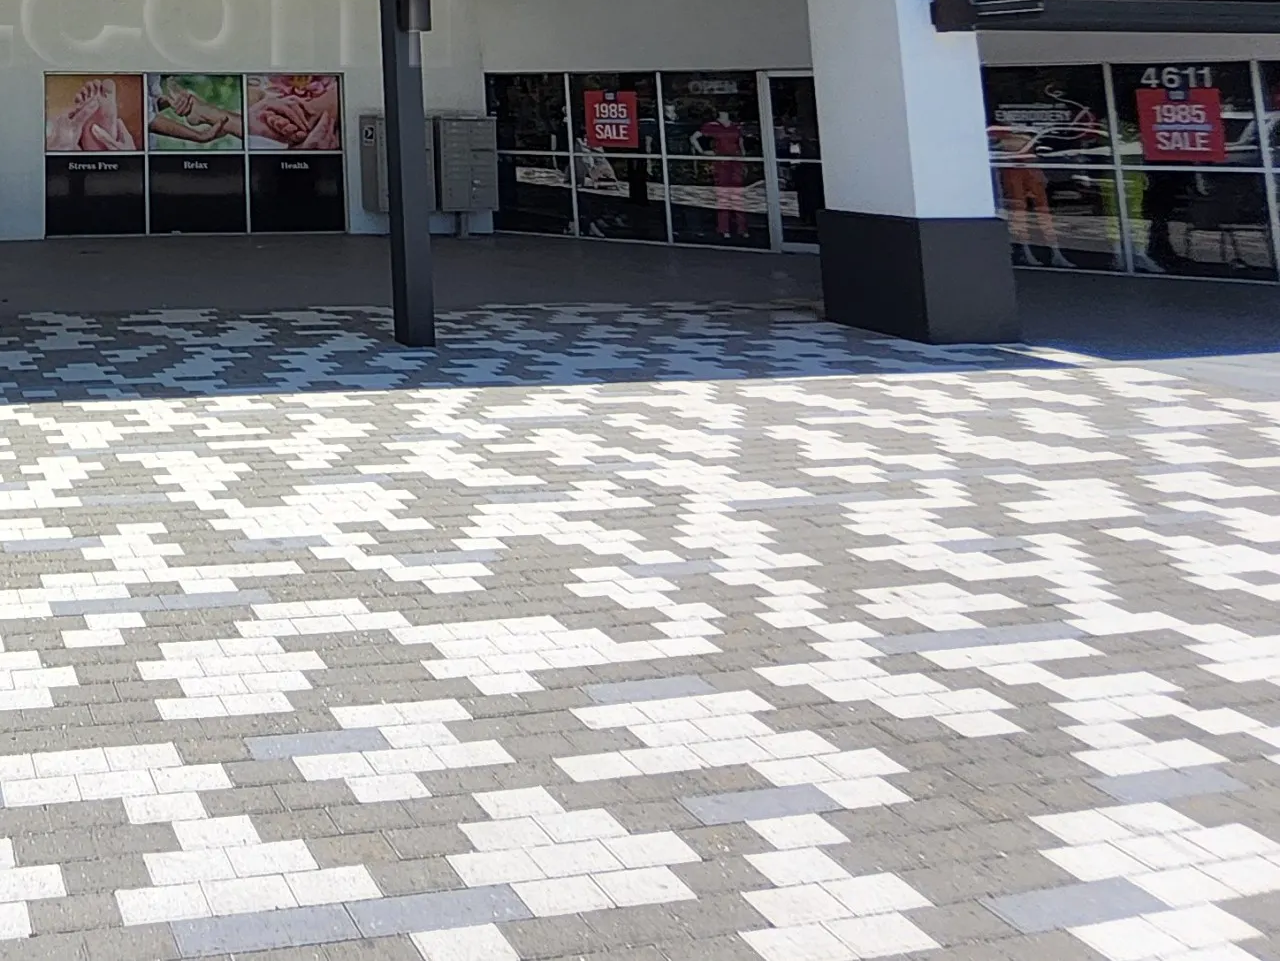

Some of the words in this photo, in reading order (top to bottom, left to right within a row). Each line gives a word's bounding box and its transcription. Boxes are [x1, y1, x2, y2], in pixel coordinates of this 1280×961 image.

[1140, 66, 1213, 88] 4611
[593, 102, 628, 119] 1985
[1152, 104, 1207, 123] 1985
[595, 123, 630, 140] SALE
[1155, 131, 1211, 151] SALE
[68, 161, 97, 170] Stress
[98, 161, 119, 170] Free
[183, 160, 209, 170] Relax
[280, 161, 310, 170] Health
